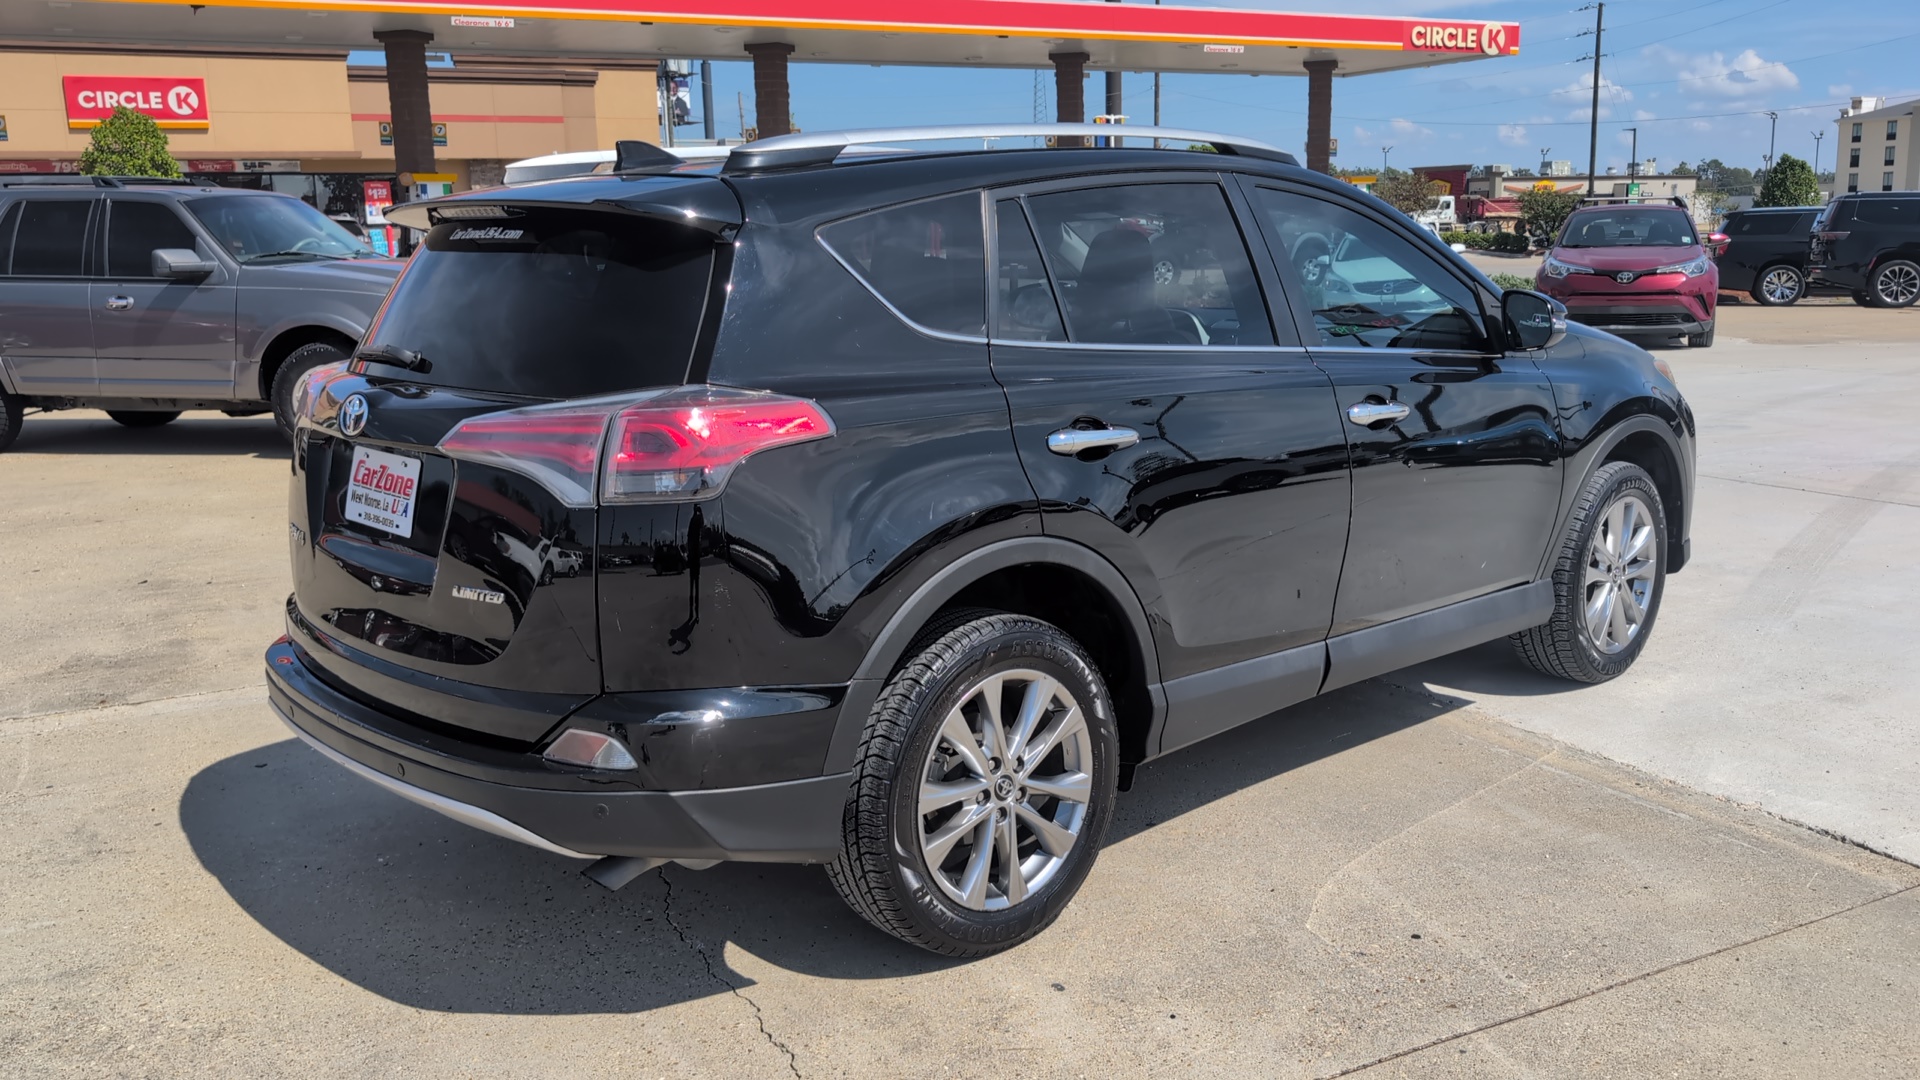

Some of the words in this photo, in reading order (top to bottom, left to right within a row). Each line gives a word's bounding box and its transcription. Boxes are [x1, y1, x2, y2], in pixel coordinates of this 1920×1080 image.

[453, 18, 490, 27] Clearance
[1411, 25, 1477, 49] CIRCLE
[1484, 25, 1504, 54] K
[77, 90, 164, 109] CIRCLE
[170, 88, 199, 114] K
[436, 126, 443, 134] 7
[353, 459, 416, 500] CarZone
[350, 489, 364, 505] West
[452, 584, 505, 605] LIMITED
